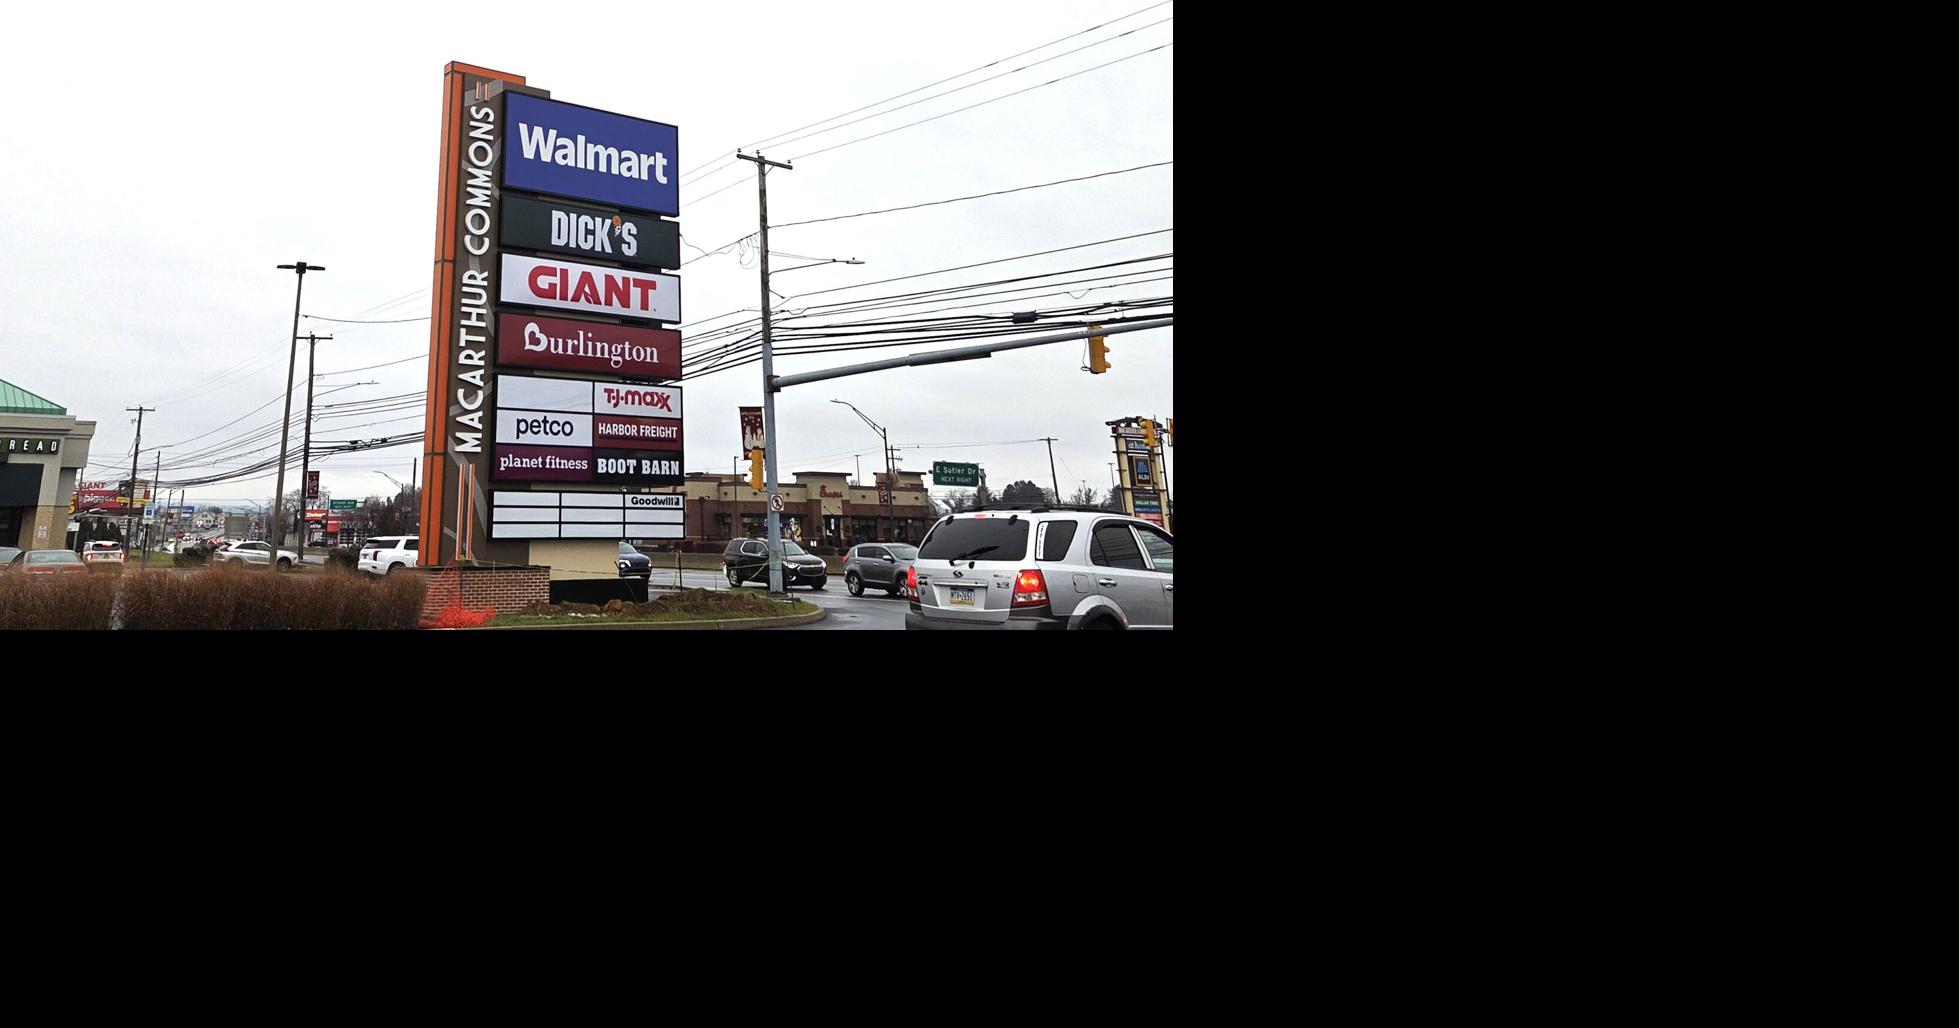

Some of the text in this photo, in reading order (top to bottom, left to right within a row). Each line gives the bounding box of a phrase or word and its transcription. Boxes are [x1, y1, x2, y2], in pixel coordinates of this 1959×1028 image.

[518, 122, 668, 184] Walmart
[551, 209, 638, 257] DICK'S
[455, 105, 495, 453] MACARTHUR COMMONS
[528, 265, 657, 312] GIANT
[523, 322, 660, 368] Burlington
[515, 415, 574, 440] petco
[598, 423, 678, 439] HARBOR FREIGHT
[0, 439, 57, 452] READ
[499, 453, 588, 471] planet fitness
[597, 458, 680, 475] BOOT BARN
[935, 465, 941, 473] E
[943, 466, 965, 475] Sutler
[631, 496, 674, 506] Goodwill
